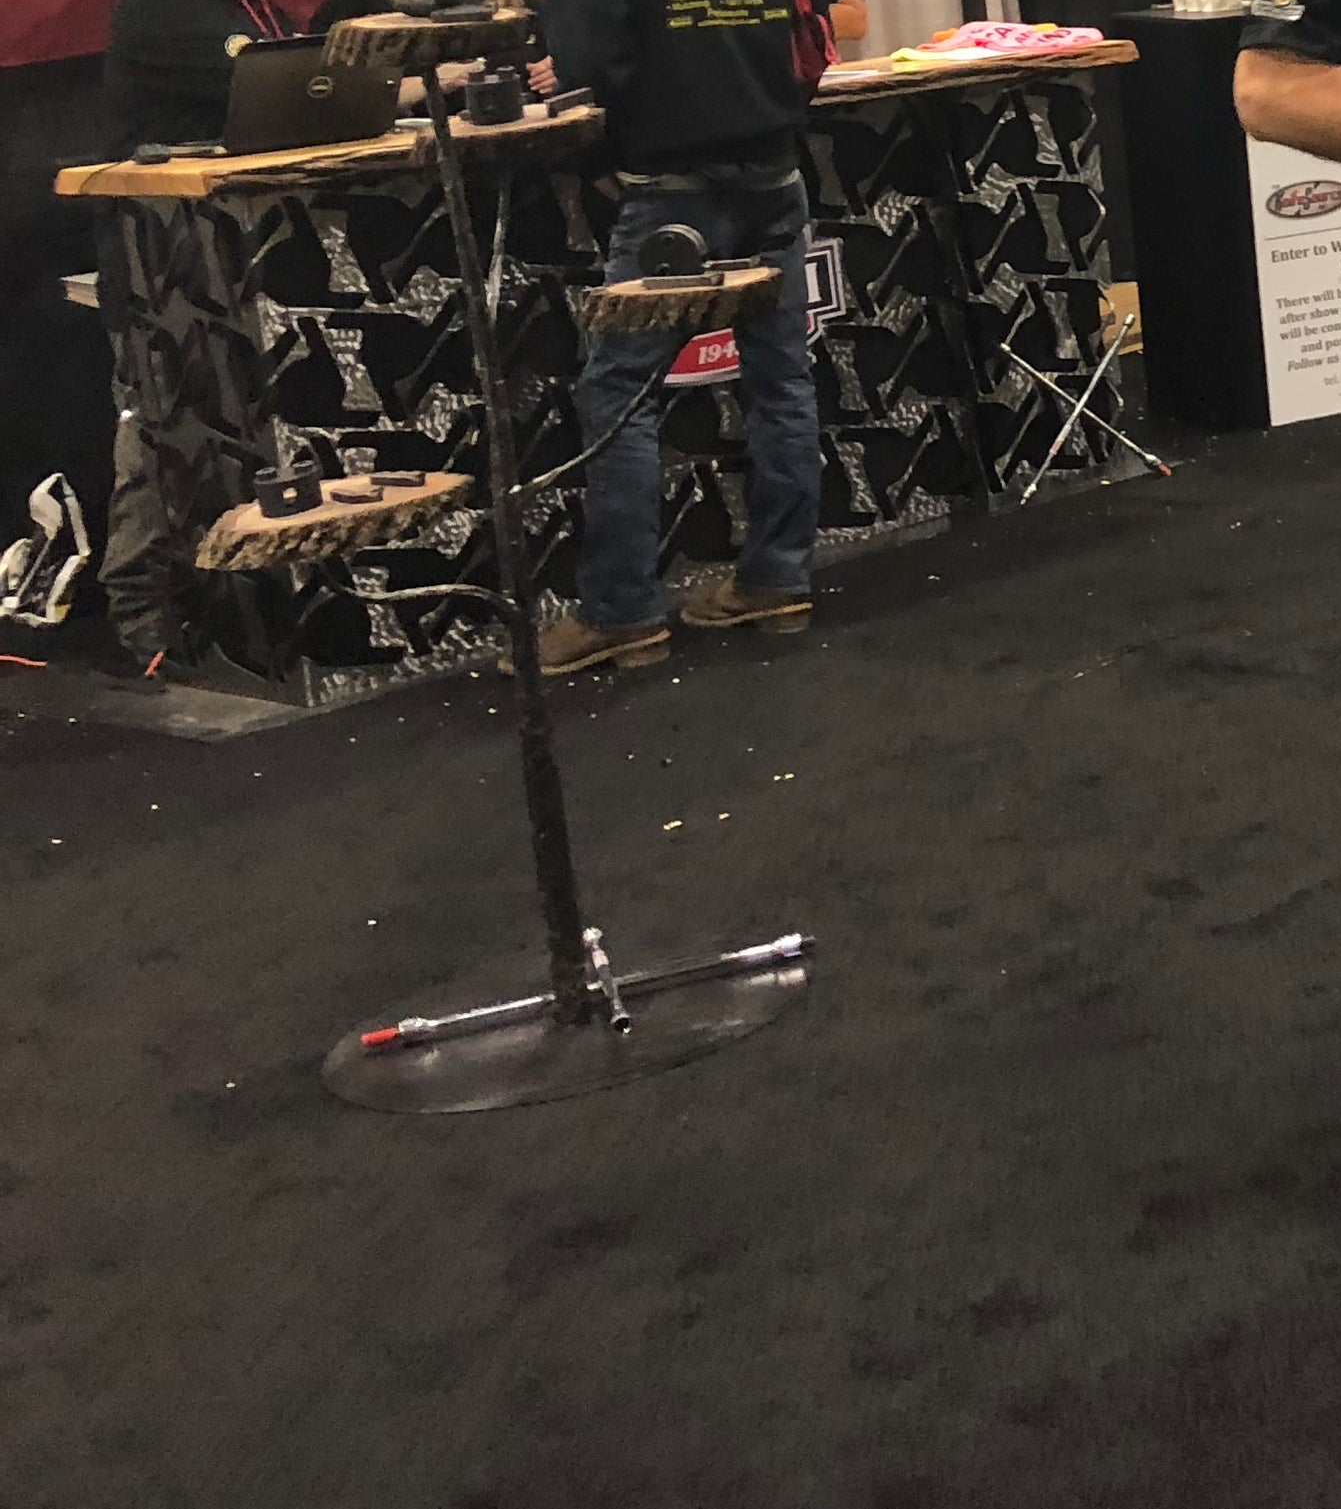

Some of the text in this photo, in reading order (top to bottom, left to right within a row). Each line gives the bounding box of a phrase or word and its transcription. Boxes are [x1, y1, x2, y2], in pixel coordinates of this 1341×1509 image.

[1270, 247, 1310, 264] Enter
[1313, 244, 1328, 256] to
[1276, 295, 1310, 309] There
[1312, 289, 1335, 303] will
[1279, 311, 1307, 325] after
[1310, 308, 1339, 319] show
[1280, 326, 1302, 340] will
[1304, 325, 1319, 336] be
[697, 339, 740, 365] 194
[1300, 339, 1323, 354] and
[1287, 357, 1323, 372] Follow
[1326, 354, 1340, 364] us
